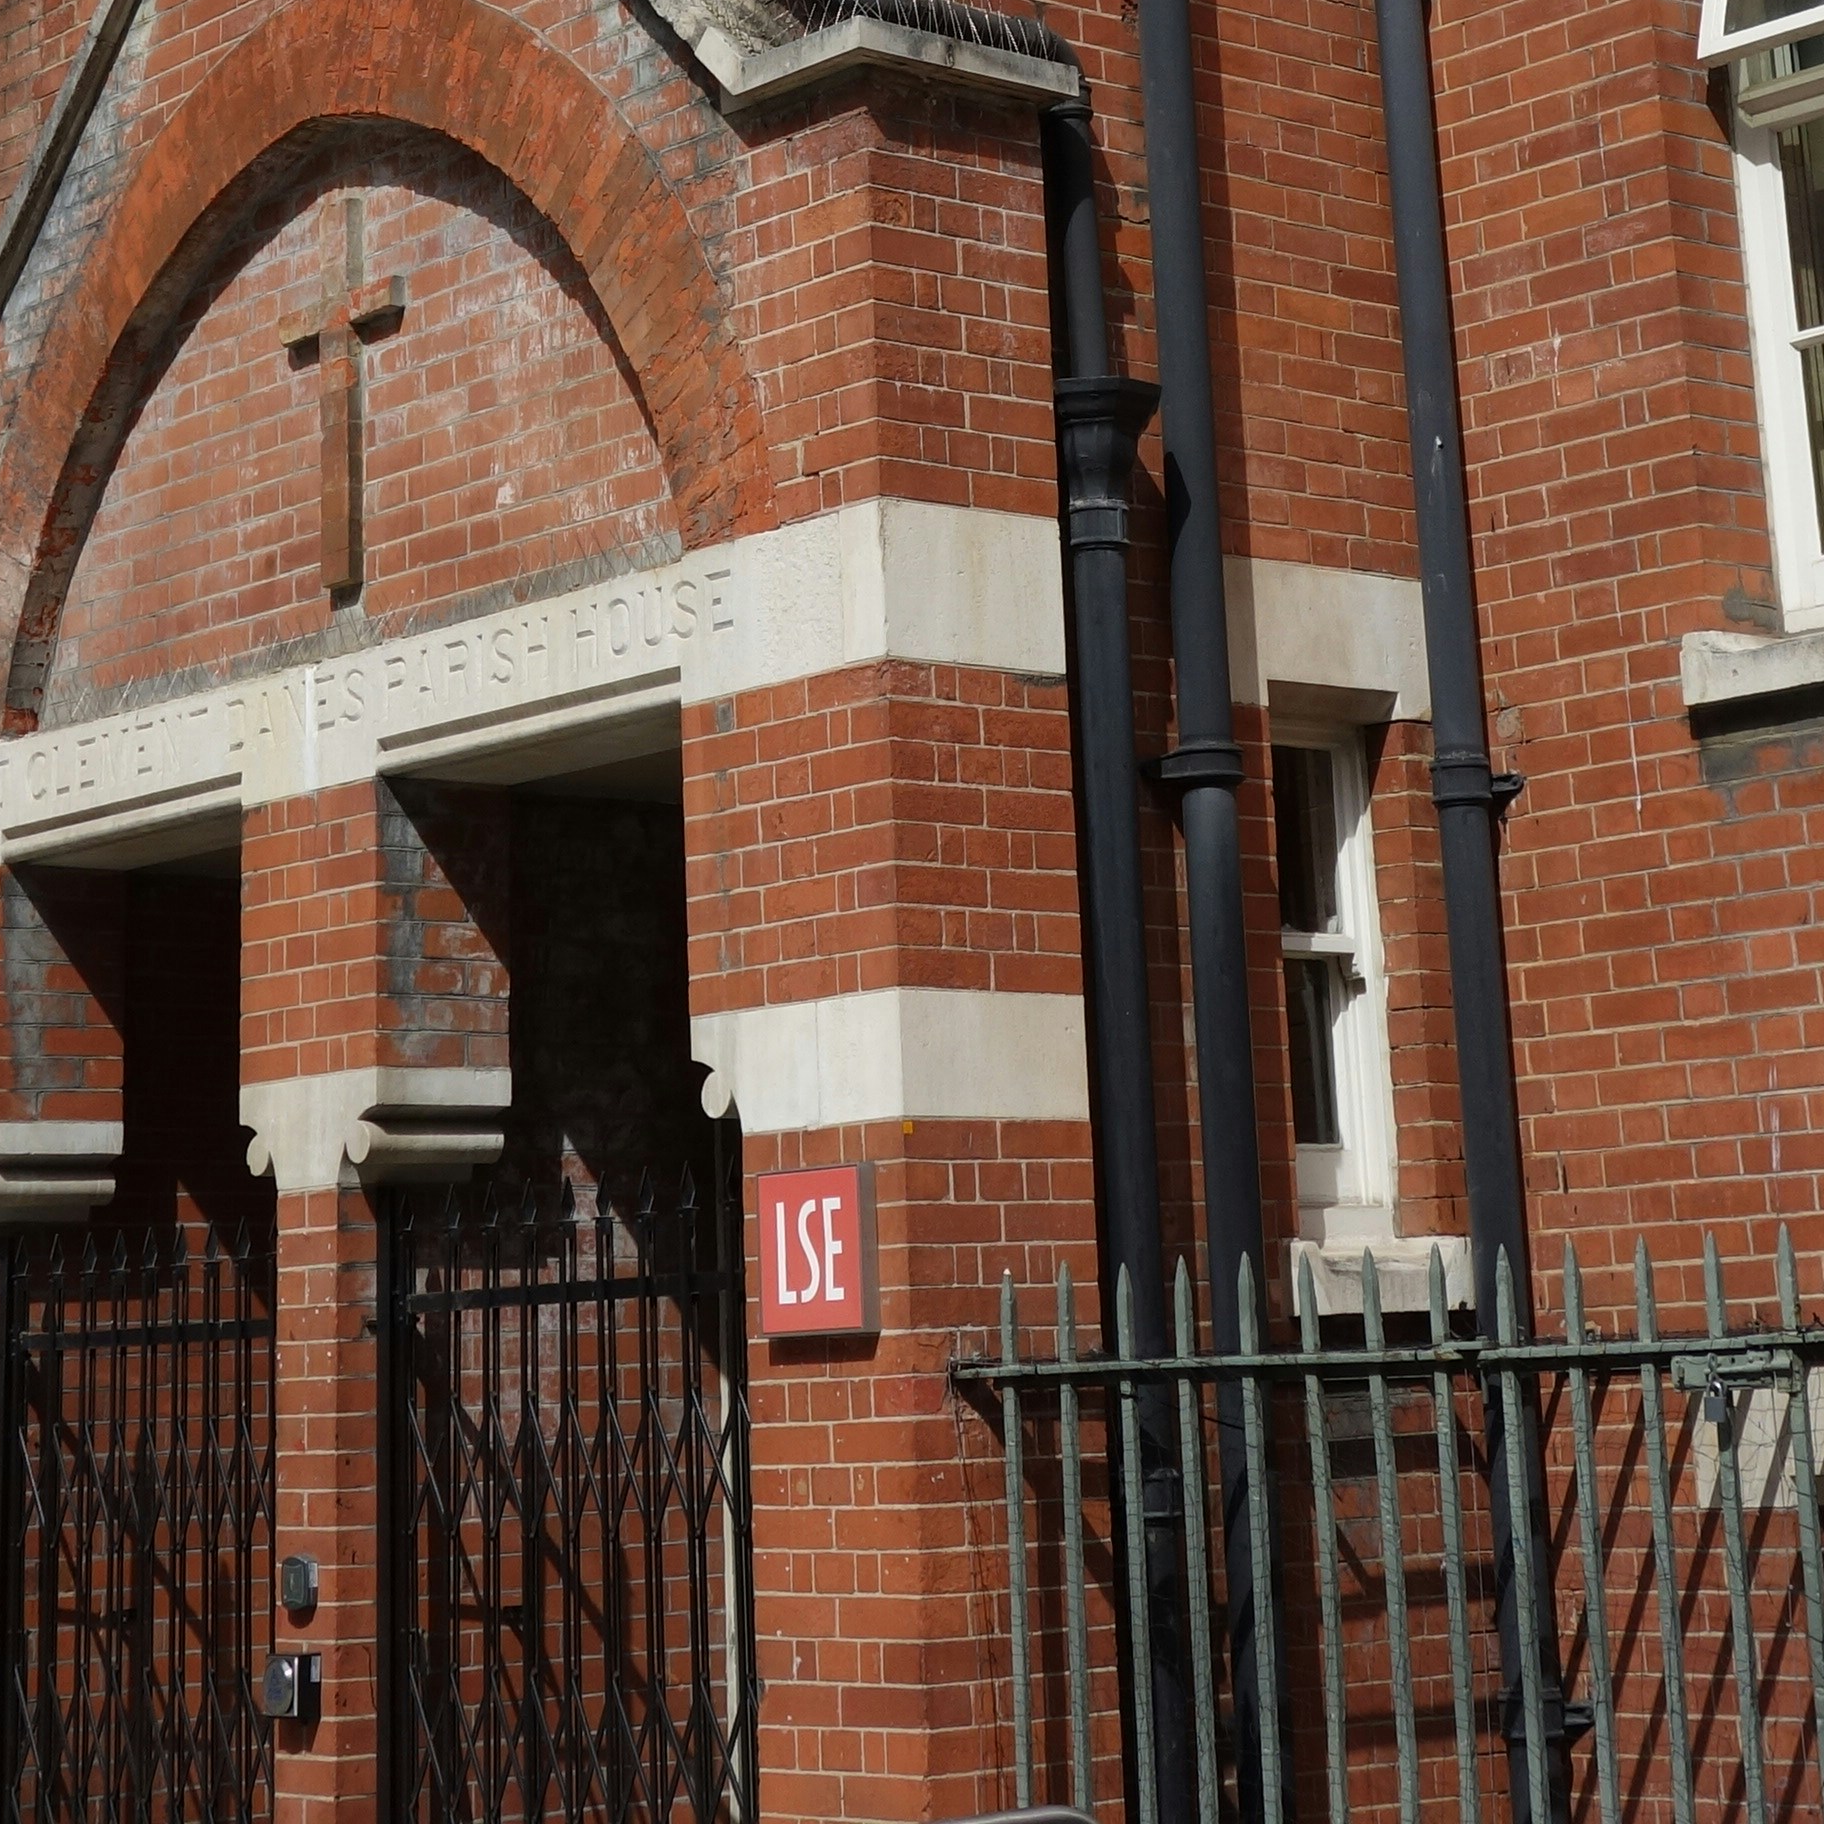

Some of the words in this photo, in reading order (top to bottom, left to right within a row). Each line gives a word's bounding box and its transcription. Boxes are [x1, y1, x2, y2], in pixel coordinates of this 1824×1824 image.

[28, 707, 209, 800] CLEMENT
[226, 668, 366, 758] DANES
[383, 616, 548, 721] PARISH
[570, 568, 734, 672] HOUSE
[776, 1196, 844, 1305] LSE
